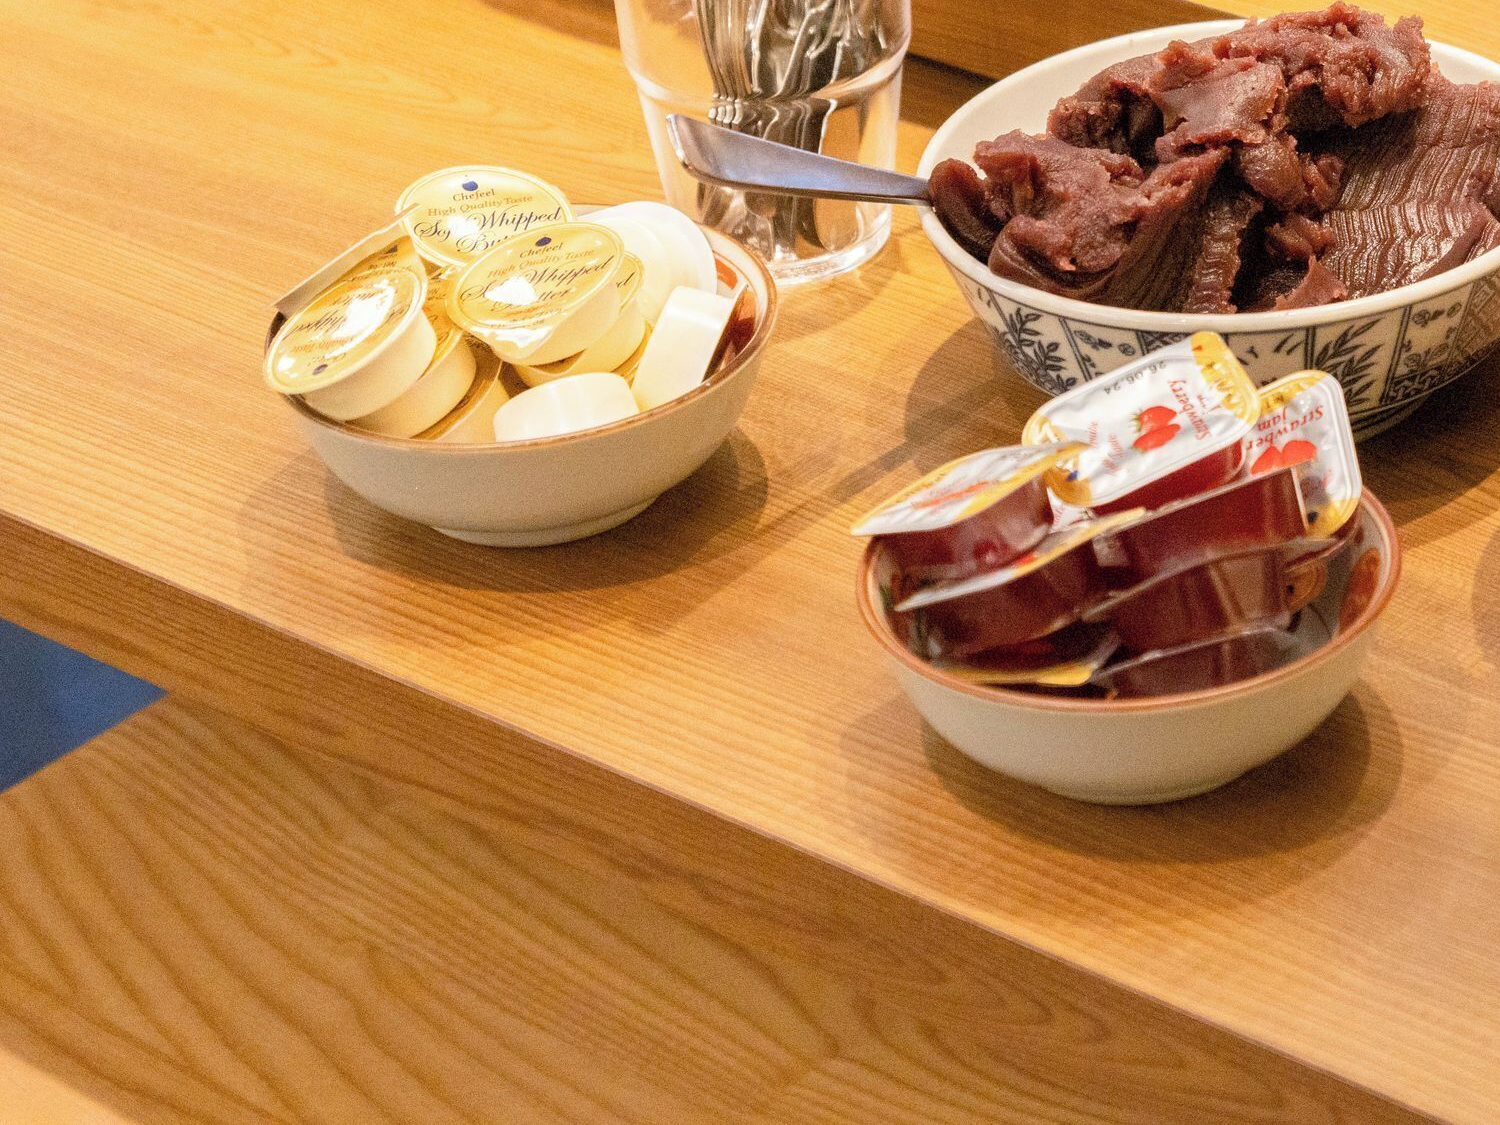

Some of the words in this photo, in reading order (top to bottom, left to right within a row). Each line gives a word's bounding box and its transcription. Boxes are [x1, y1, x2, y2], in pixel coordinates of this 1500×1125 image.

[428, 206, 456, 217] High
[460, 200, 502, 214] Quality
[504, 194, 533, 204] Taste
[452, 188, 496, 203] Chefeel
[467, 204, 563, 232] Whipped
[518, 255, 564, 271] Quality
[566, 249, 596, 260] Taste
